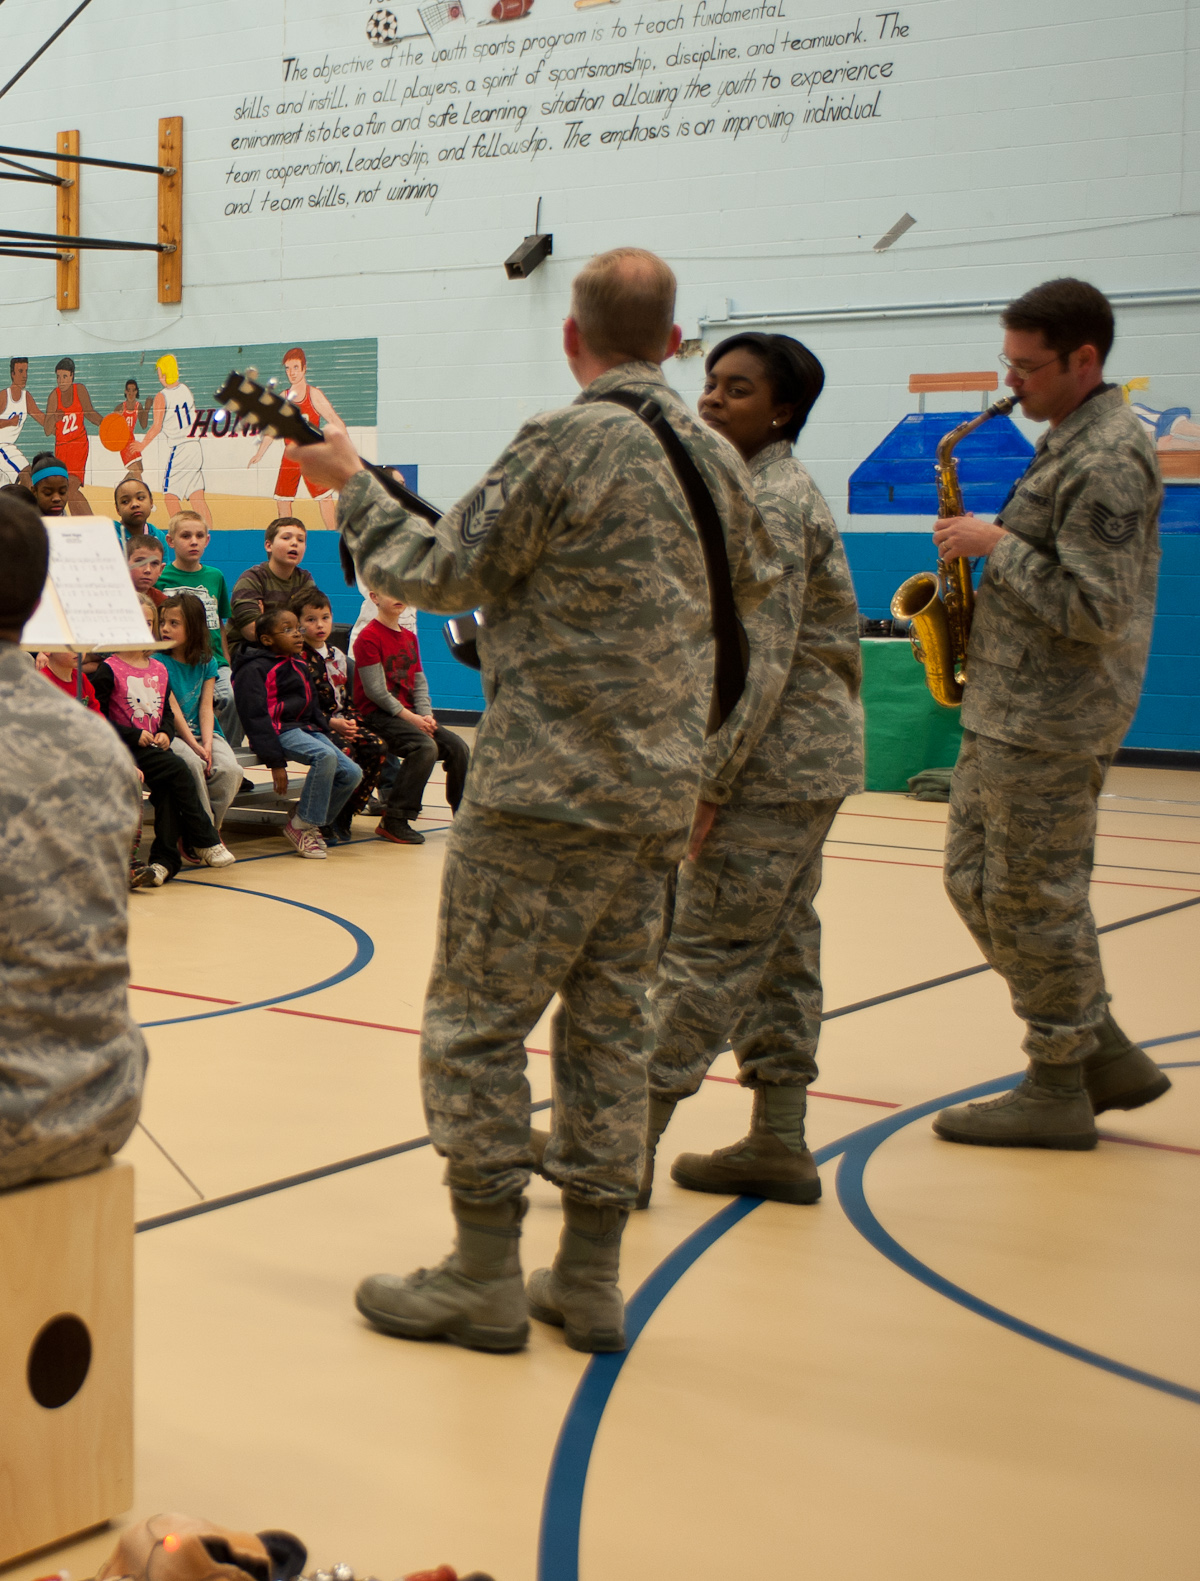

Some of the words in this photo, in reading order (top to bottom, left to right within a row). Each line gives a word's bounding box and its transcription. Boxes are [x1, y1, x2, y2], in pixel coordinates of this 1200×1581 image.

[234, 96, 270, 120] skills
[276, 90, 308, 115] and
[354, 87, 366, 106] in
[373, 79, 397, 104] all
[465, 80, 476, 92] a
[482, 65, 519, 97] spirit
[525, 59, 545, 86] of
[747, 29, 778, 57] and
[875, 11, 910, 40] The
[283, 57, 308, 82] The
[313, 54, 374, 84] objective
[381, 45, 398, 69] of
[399, 43, 424, 66] the
[431, 34, 467, 72] youth
[473, 34, 516, 63] sports
[519, 30, 587, 60] program
[591, 22, 604, 42] is
[611, 17, 627, 39] to
[634, 4, 684, 36] teach
[225, 162, 261, 185] team
[437, 135, 471, 162] and
[563, 121, 591, 148] The
[600, 115, 670, 151] emphasis
[676, 116, 690, 137] is
[694, 118, 715, 136] an
[722, 104, 795, 143] improving
[803, 90, 882, 124] individual
[230, 122, 303, 150] environment
[305, 124, 315, 143] is
[317, 121, 331, 142] to
[333, 116, 350, 139] be
[353, 124, 363, 137] a
[365, 112, 386, 134] fun
[391, 107, 424, 133] and
[427, 103, 458, 129] safe
[540, 88, 605, 116] situation
[612, 81, 681, 119] allowing
[684, 74, 711, 100] the
[711, 68, 757, 109] youth
[762, 69, 781, 91] to
[790, 60, 894, 97] experience
[224, 189, 256, 216] and
[261, 191, 304, 212] team
[354, 180, 381, 204] not
[386, 178, 439, 216] winning
[61, 412, 78, 435] 22
[174, 401, 192, 430] 11
